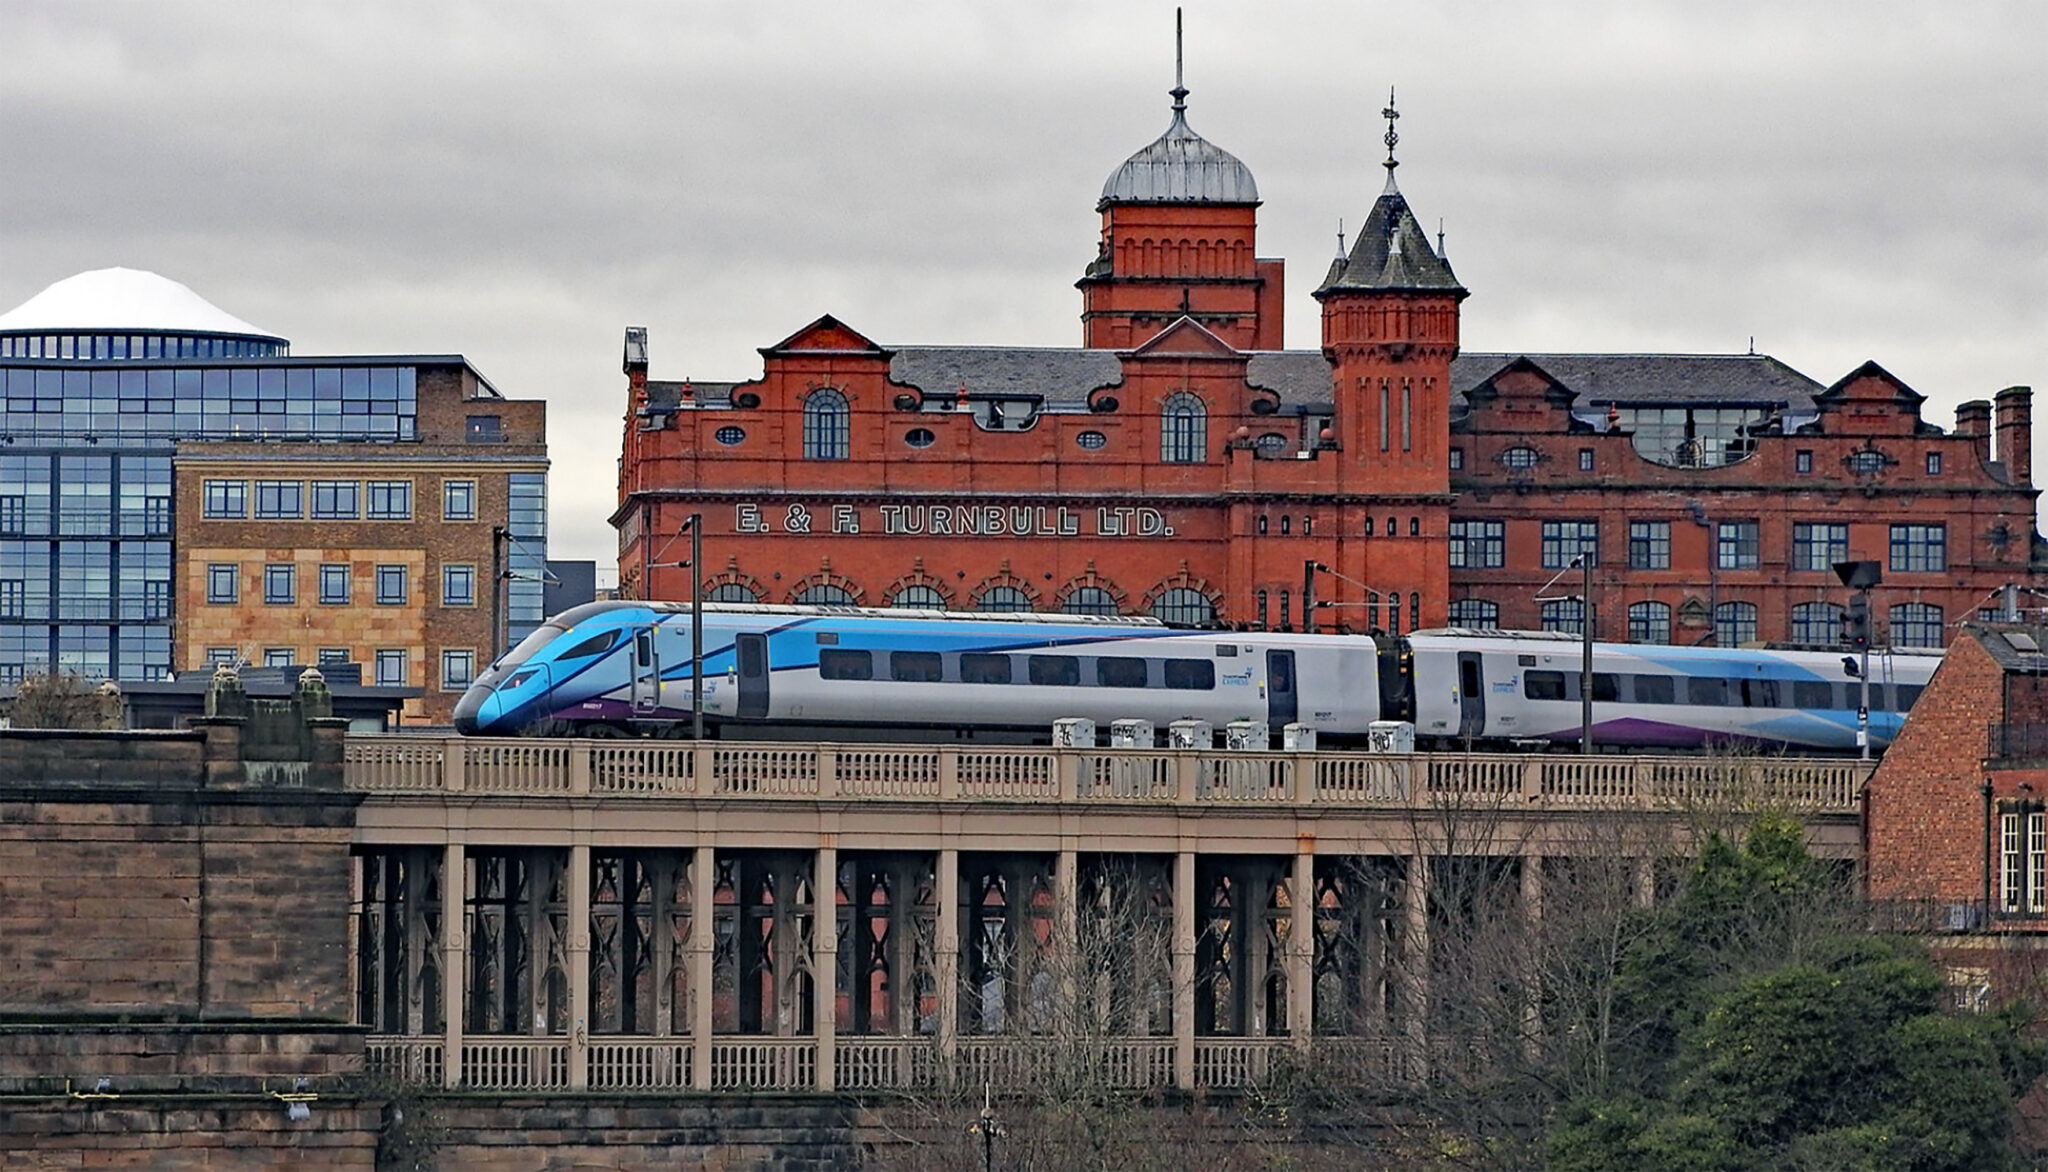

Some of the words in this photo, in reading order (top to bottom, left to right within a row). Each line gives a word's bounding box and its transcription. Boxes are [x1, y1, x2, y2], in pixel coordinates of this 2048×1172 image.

[735, 503, 769, 532] E.
[783, 503, 811, 533] &
[832, 504, 859, 534] F.
[880, 505, 1077, 535] TURNBULL
[1097, 507, 1174, 535] LTD.
